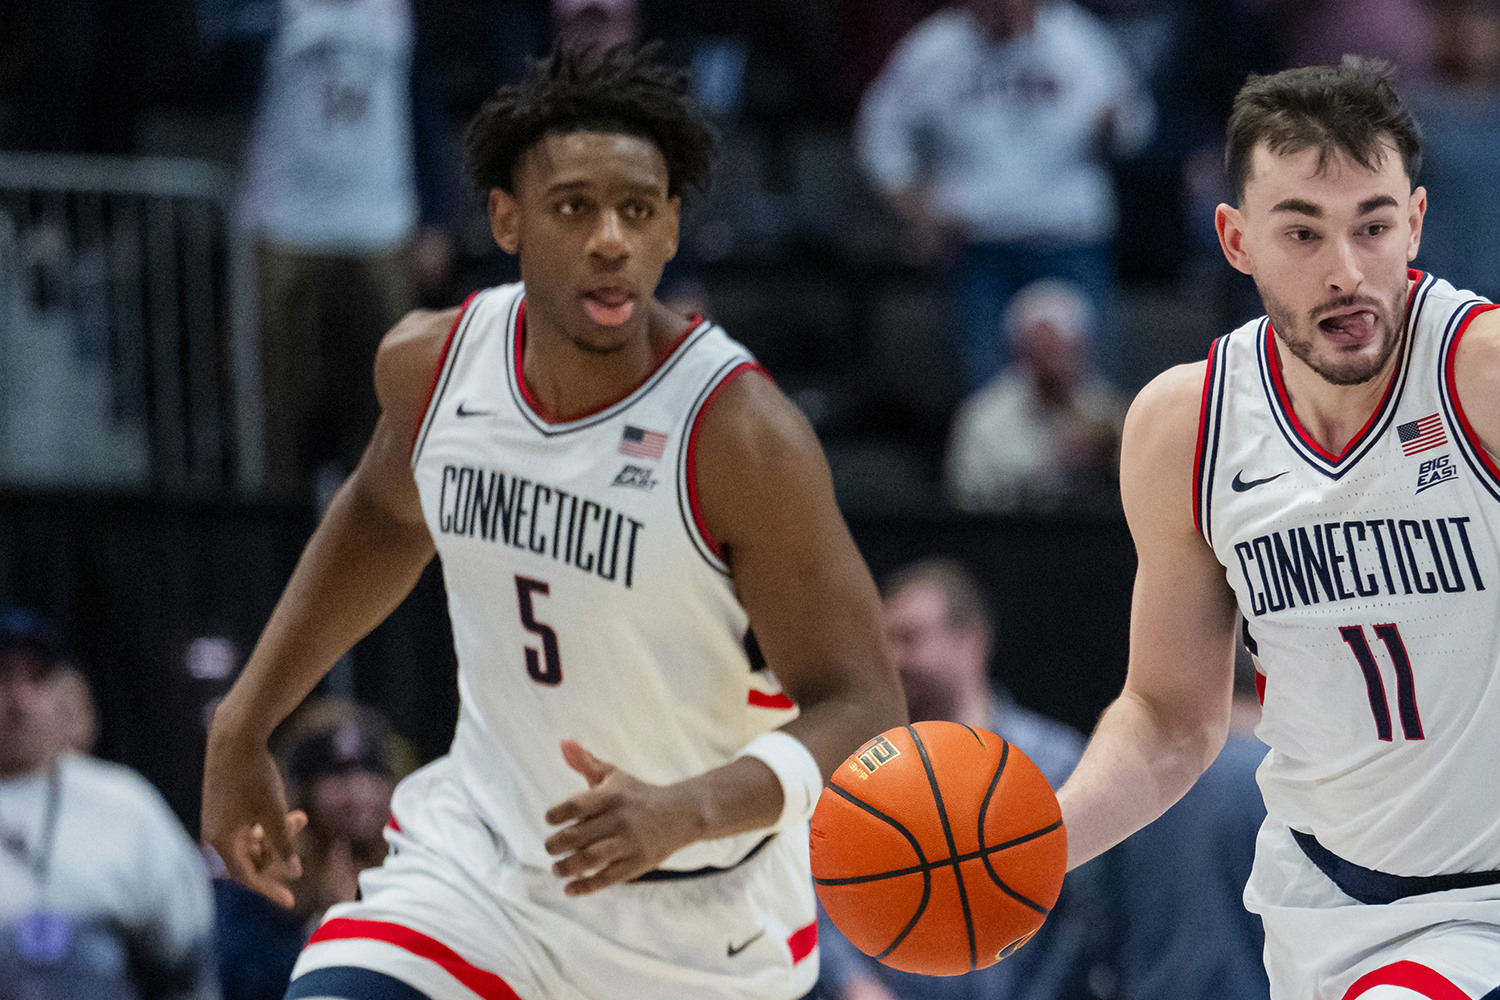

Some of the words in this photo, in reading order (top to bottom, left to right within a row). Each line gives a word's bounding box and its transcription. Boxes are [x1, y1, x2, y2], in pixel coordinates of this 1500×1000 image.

[1417, 465, 1457, 487] EAST
[1419, 454, 1450, 475] BIG
[440, 465, 645, 589] CONNECTICUT
[1234, 516, 1486, 617] CONNECTICUT
[513, 573, 564, 688] 5
[1338, 622, 1426, 742] 11
